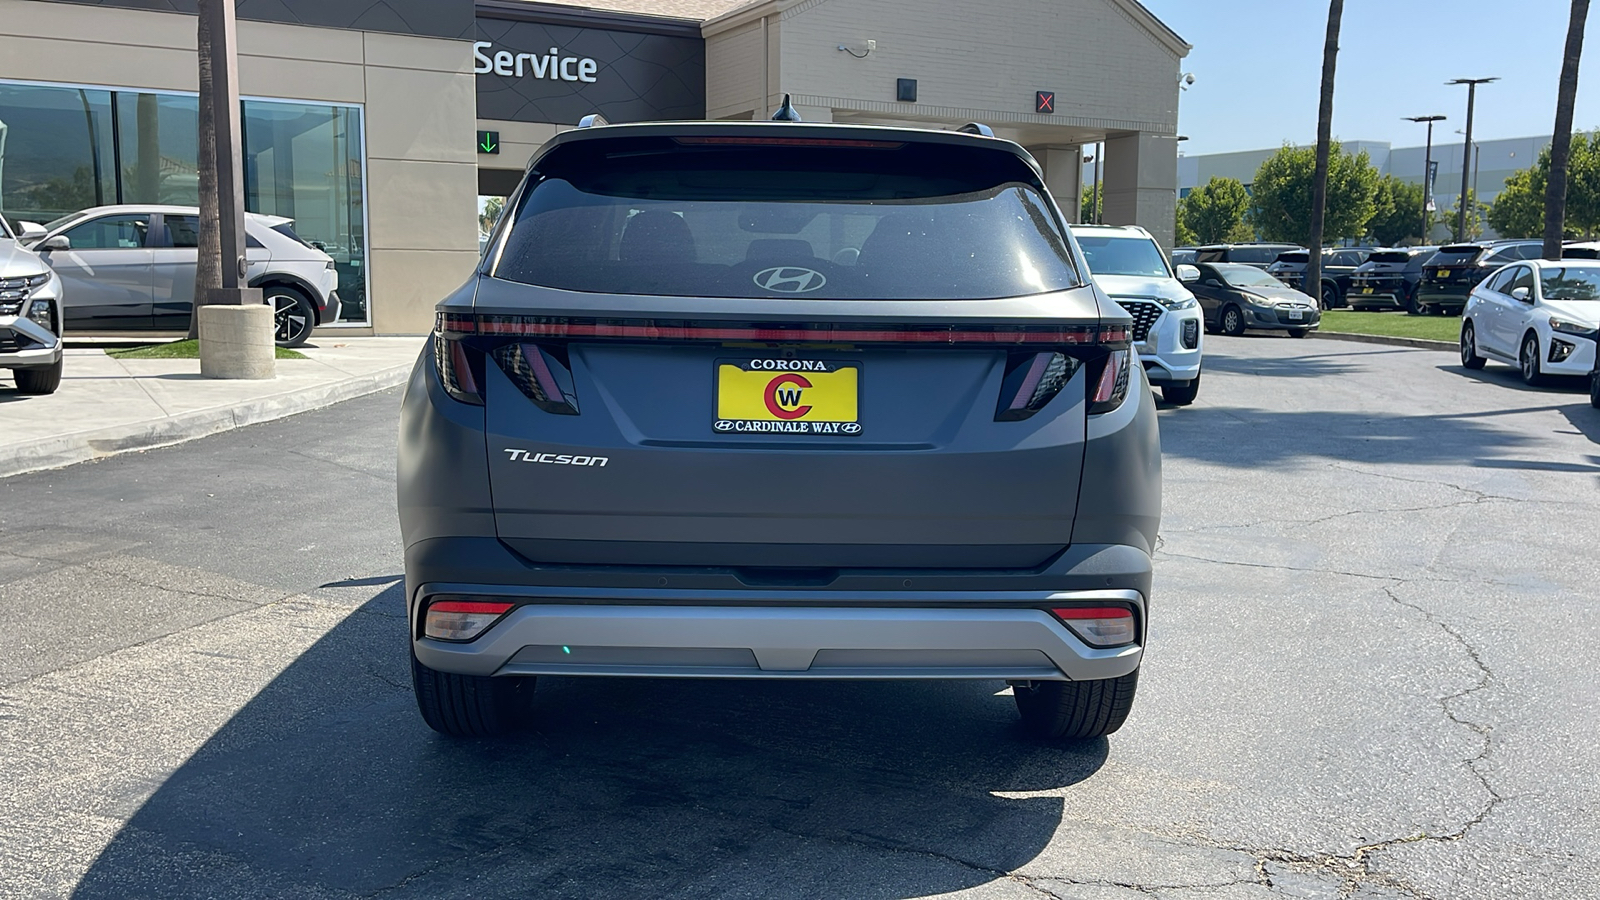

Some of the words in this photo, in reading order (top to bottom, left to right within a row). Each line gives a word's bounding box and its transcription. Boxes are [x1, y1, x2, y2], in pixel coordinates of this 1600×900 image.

[473, 41, 597, 83] Service
[750, 359, 827, 371] CORONA
[735, 420, 809, 433] CARDINALE
[812, 422, 841, 433] WAY
